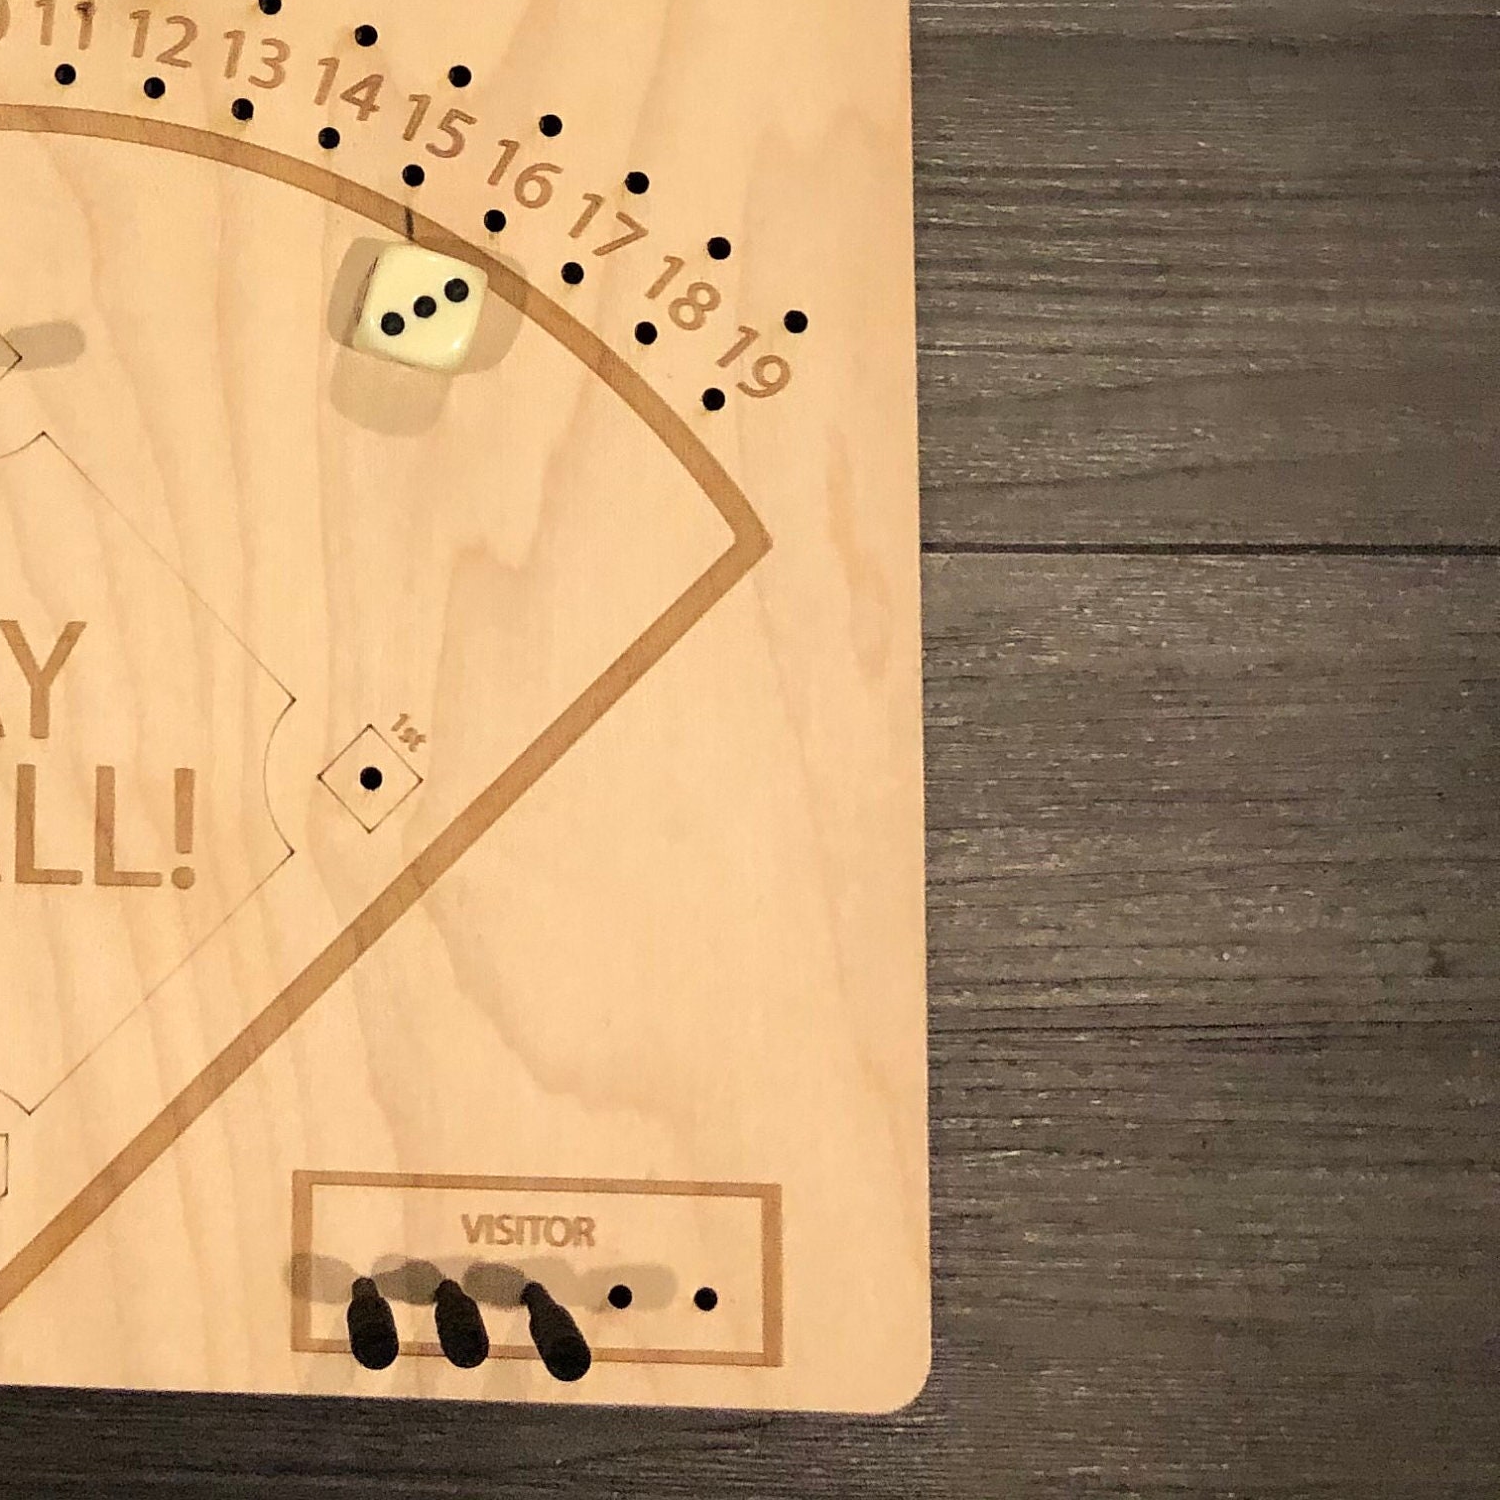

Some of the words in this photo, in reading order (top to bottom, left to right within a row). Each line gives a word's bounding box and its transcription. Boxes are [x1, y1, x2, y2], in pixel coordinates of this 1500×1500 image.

[128, 9, 198, 67] 12
[224, 30, 290, 89] 13
[313, 57, 385, 122] 14
[403, 94, 477, 159] 15
[487, 140, 563, 208] 16
[569, 192, 648, 259] 17
[644, 256, 720, 330] 18
[716, 325, 791, 399] 19
[391, 712, 426, 752] 1st
[461, 1214, 596, 1247] VISITOR
